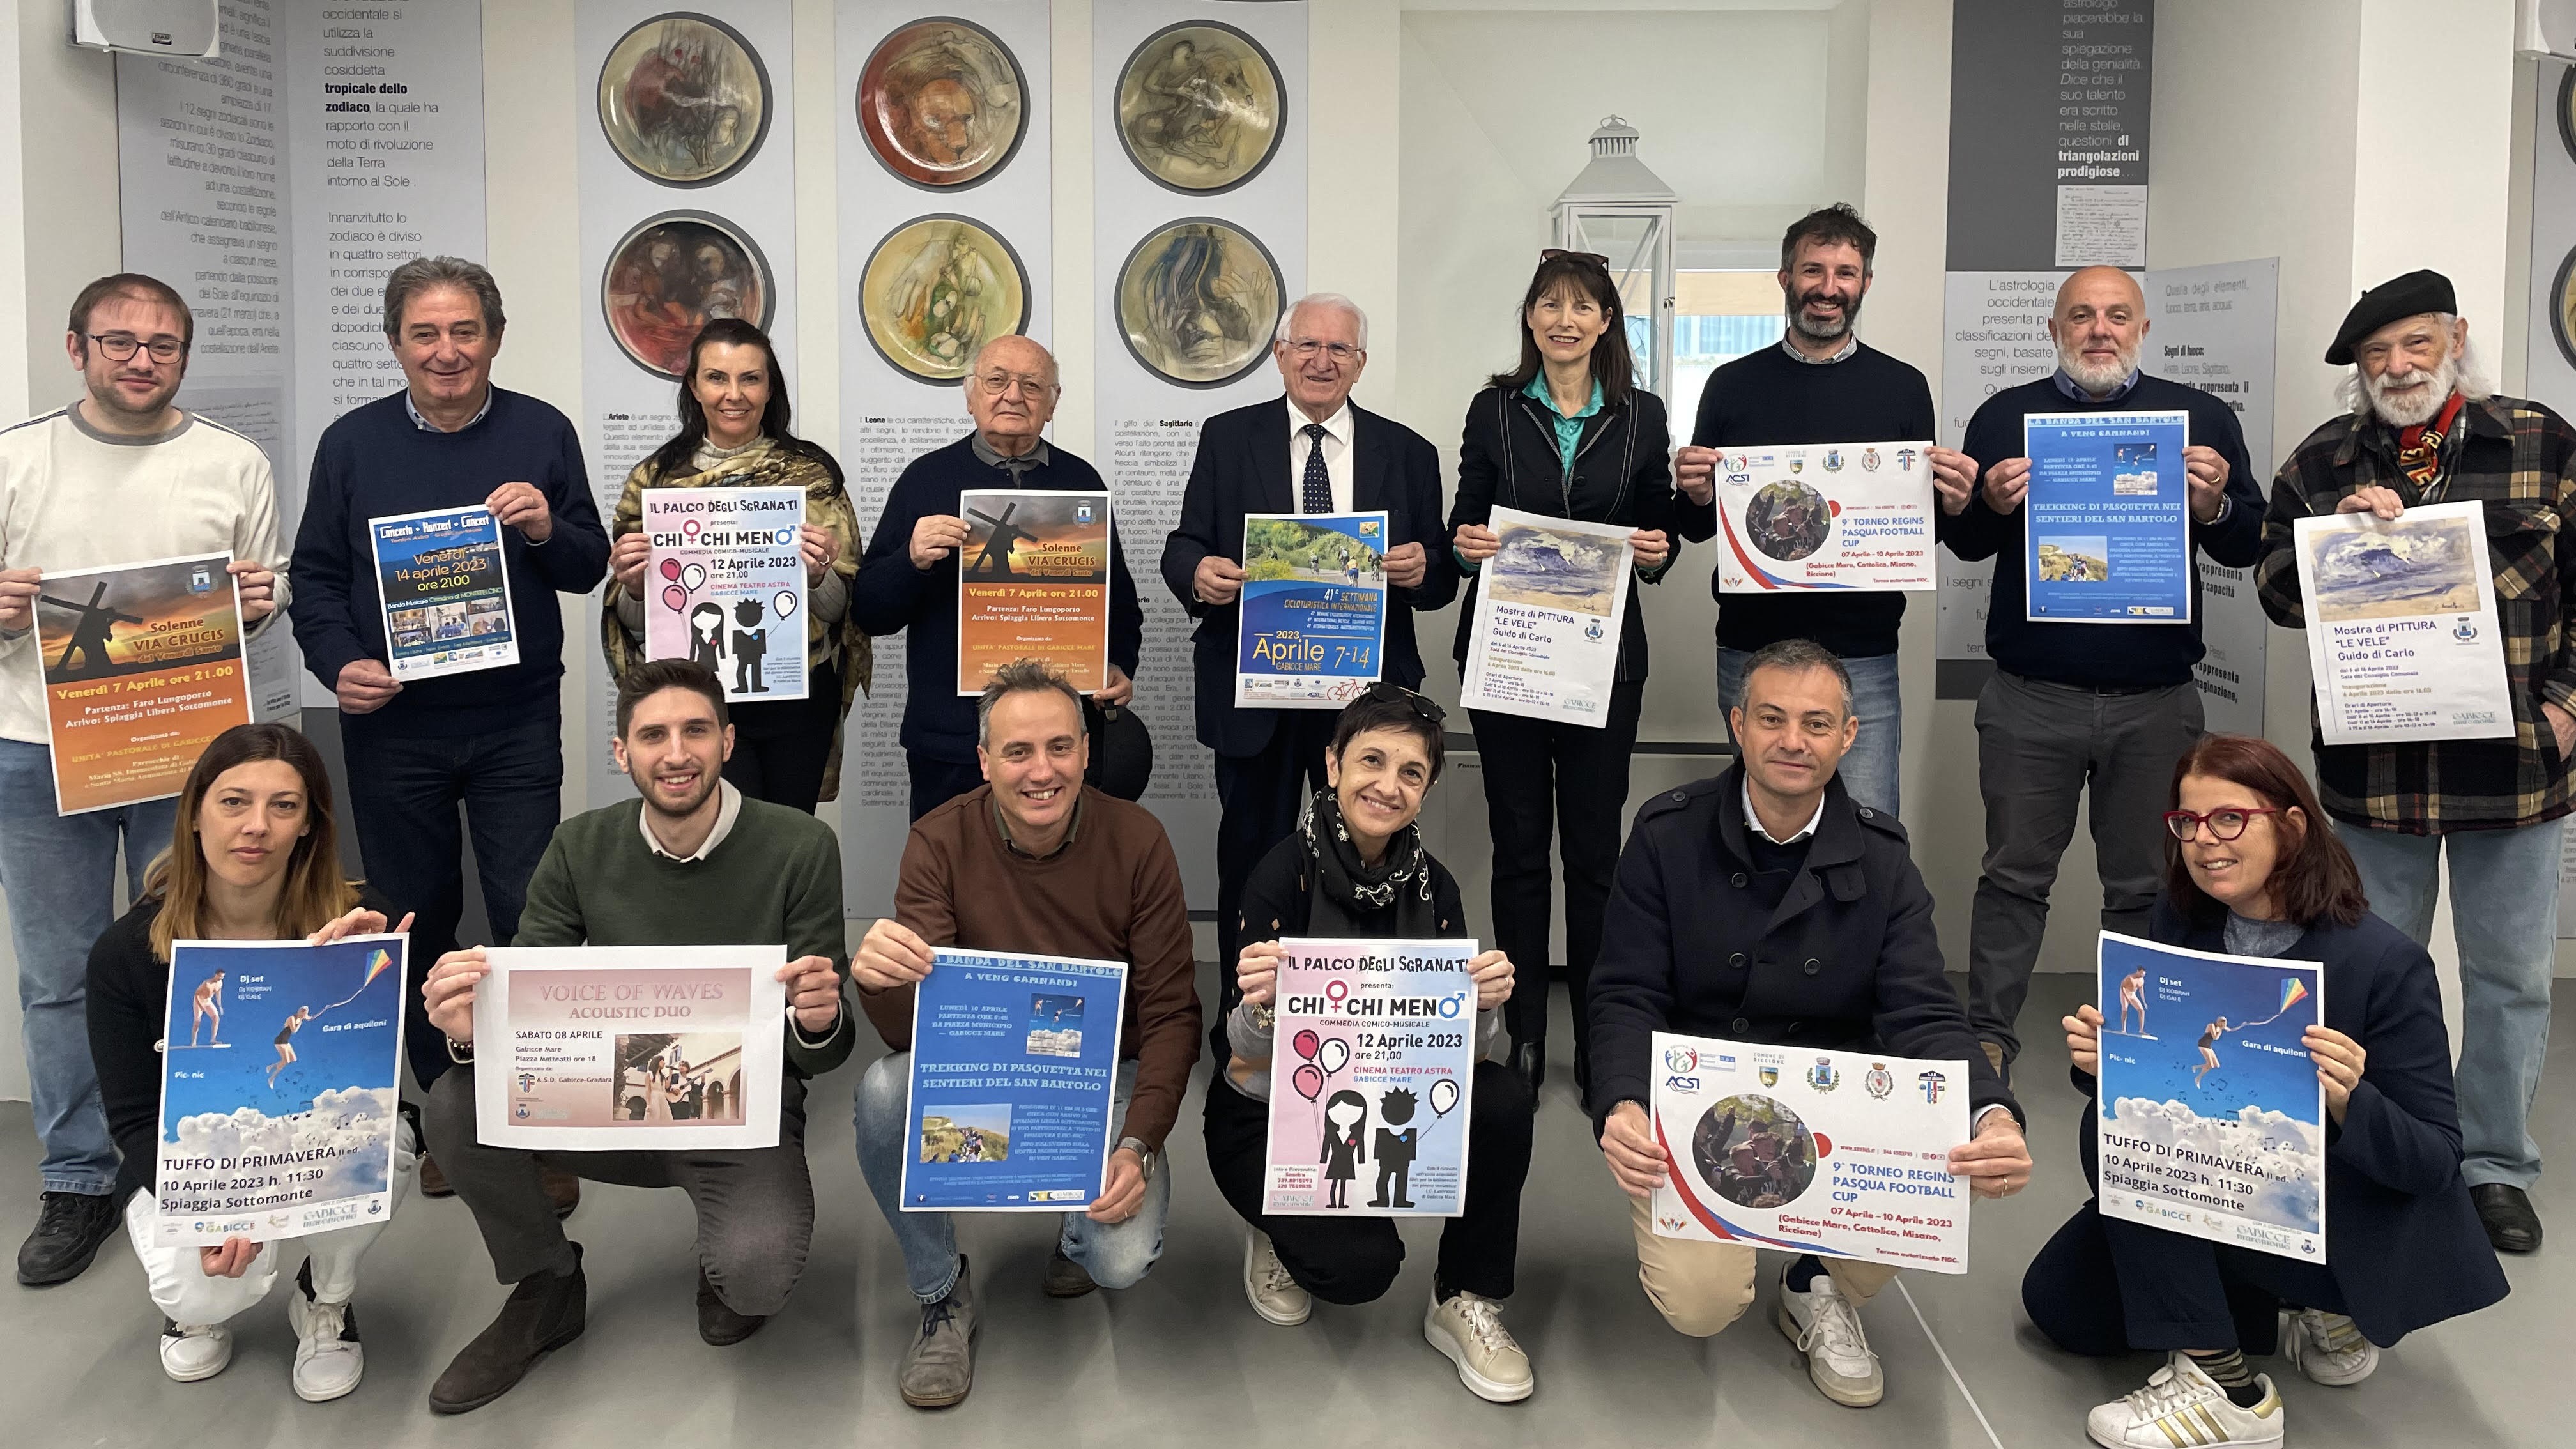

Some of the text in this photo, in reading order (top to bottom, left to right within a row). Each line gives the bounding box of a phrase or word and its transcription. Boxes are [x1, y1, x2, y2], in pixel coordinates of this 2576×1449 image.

[323, 10, 402, 20] occidentale si
[325, 83, 408, 95] tropicale dello
[376, 102, 385, 112] la
[389, 102, 420, 115] quale
[424, 102, 438, 112] ha
[2060, 105, 2118, 116] era scritto
[326, 139, 434, 150] moto di rivoluzione
[2059, 135, 2129, 148] questioni di
[327, 157, 385, 168] della Terra
[2058, 150, 2140, 164] triangolazioni
[2058, 166, 2120, 179] prodigiose
[329, 231, 422, 241] zodiaco è diviso
[1989, 279, 2055, 293] L'astrologia
[1988, 297, 2055, 307] occidentale
[1955, 330, 2033, 341] classificazioni
[2013, 348, 2053, 358] basate
[650, 499, 797, 514] IL PALCO DEGLI SGRANATI
[2103, 503, 2160, 511] PASQUETTA
[1854, 518, 1889, 526] TORNEO
[1042, 543, 1082, 552] Solenne
[1028, 556, 1096, 566] VIA CRUCIS
[395, 559, 487, 581] 14 aprile 2023
[417, 582, 438, 592] ore
[1340, 592, 1377, 602] SETTIMANA
[1284, 599, 1377, 612] CICLOTURISTICA INTERNAZIONALE
[1496, 606, 1574, 625] Mostra di PITTURA
[151, 618, 204, 634] Solenne
[2334, 621, 2437, 635] Mostra di PITTURA
[133, 629, 224, 652] VIA CRUCIS
[1276, 631, 1300, 639] 2023
[1492, 627, 1552, 643] Guido di Carlo
[1252, 638, 1324, 666] Aprile
[1276, 661, 1321, 671] GABICCE MARE
[57, 666, 234, 700] Venerdì 7 Aprile ore 21.00
[134, 698, 154, 709] Faro
[158, 690, 213, 705] Lungoporto
[1288, 956, 1395, 972] IL PALCO DEGLI
[965, 972, 972, 981] A
[977, 973, 1009, 982] VENG
[2159, 976, 2182, 987] Dj set
[540, 983, 723, 1001] VOICE OF WAVES
[569, 1006, 691, 1018] ACOUSTIC DUO
[1288, 996, 1324, 1014] CHI
[1347, 998, 1383, 1016] CHI
[1319, 1019, 1360, 1027] COMMEDIA
[516, 1031, 603, 1039] SABATO 08 APRILE
[1356, 1033, 1462, 1052] 12 Aprile 2023
[2242, 1039, 2306, 1059] Gara di aquiloni
[1375, 1051, 1402, 1062] 21,00
[2124, 1056, 2136, 1064] nic
[920, 1064, 1107, 1078] TREKKING DI PASQUETTA NEI
[923, 1078, 1101, 1091] SENTIERI DEL SAN BARTOLO
[163, 1147, 336, 1171] TUFFO DI PRIMAVERA
[2104, 1133, 2151, 1154] TUFFO
[2156, 1144, 2170, 1158] DI
[2175, 1148, 2265, 1178] PRIMAVERA
[1851, 1163, 1903, 1179] TORNEO
[1908, 1169, 1955, 1183] REGINS
[2104, 1154, 2253, 1195] 10 Aprile 2023 h. 11:30
[1833, 1176, 1955, 1199] PASQUA FOOTBALL
[2104, 1170, 2245, 1212] Spiaggia Sottomonte
[161, 1188, 314, 1211] Spiaggia Sottomonte
[1832, 1191, 1858, 1202] CUP
[1844, 1208, 1873, 1220] Aprile
[1883, 1213, 1893, 1221] 10
[1896, 1215, 1924, 1226] Aprile
[1927, 1218, 1952, 1228] 2023
[1779, 1213, 1942, 1243] (Gabicce Mare, Cattolica, Misano,
[1779, 1224, 1821, 1239] Riccione)
